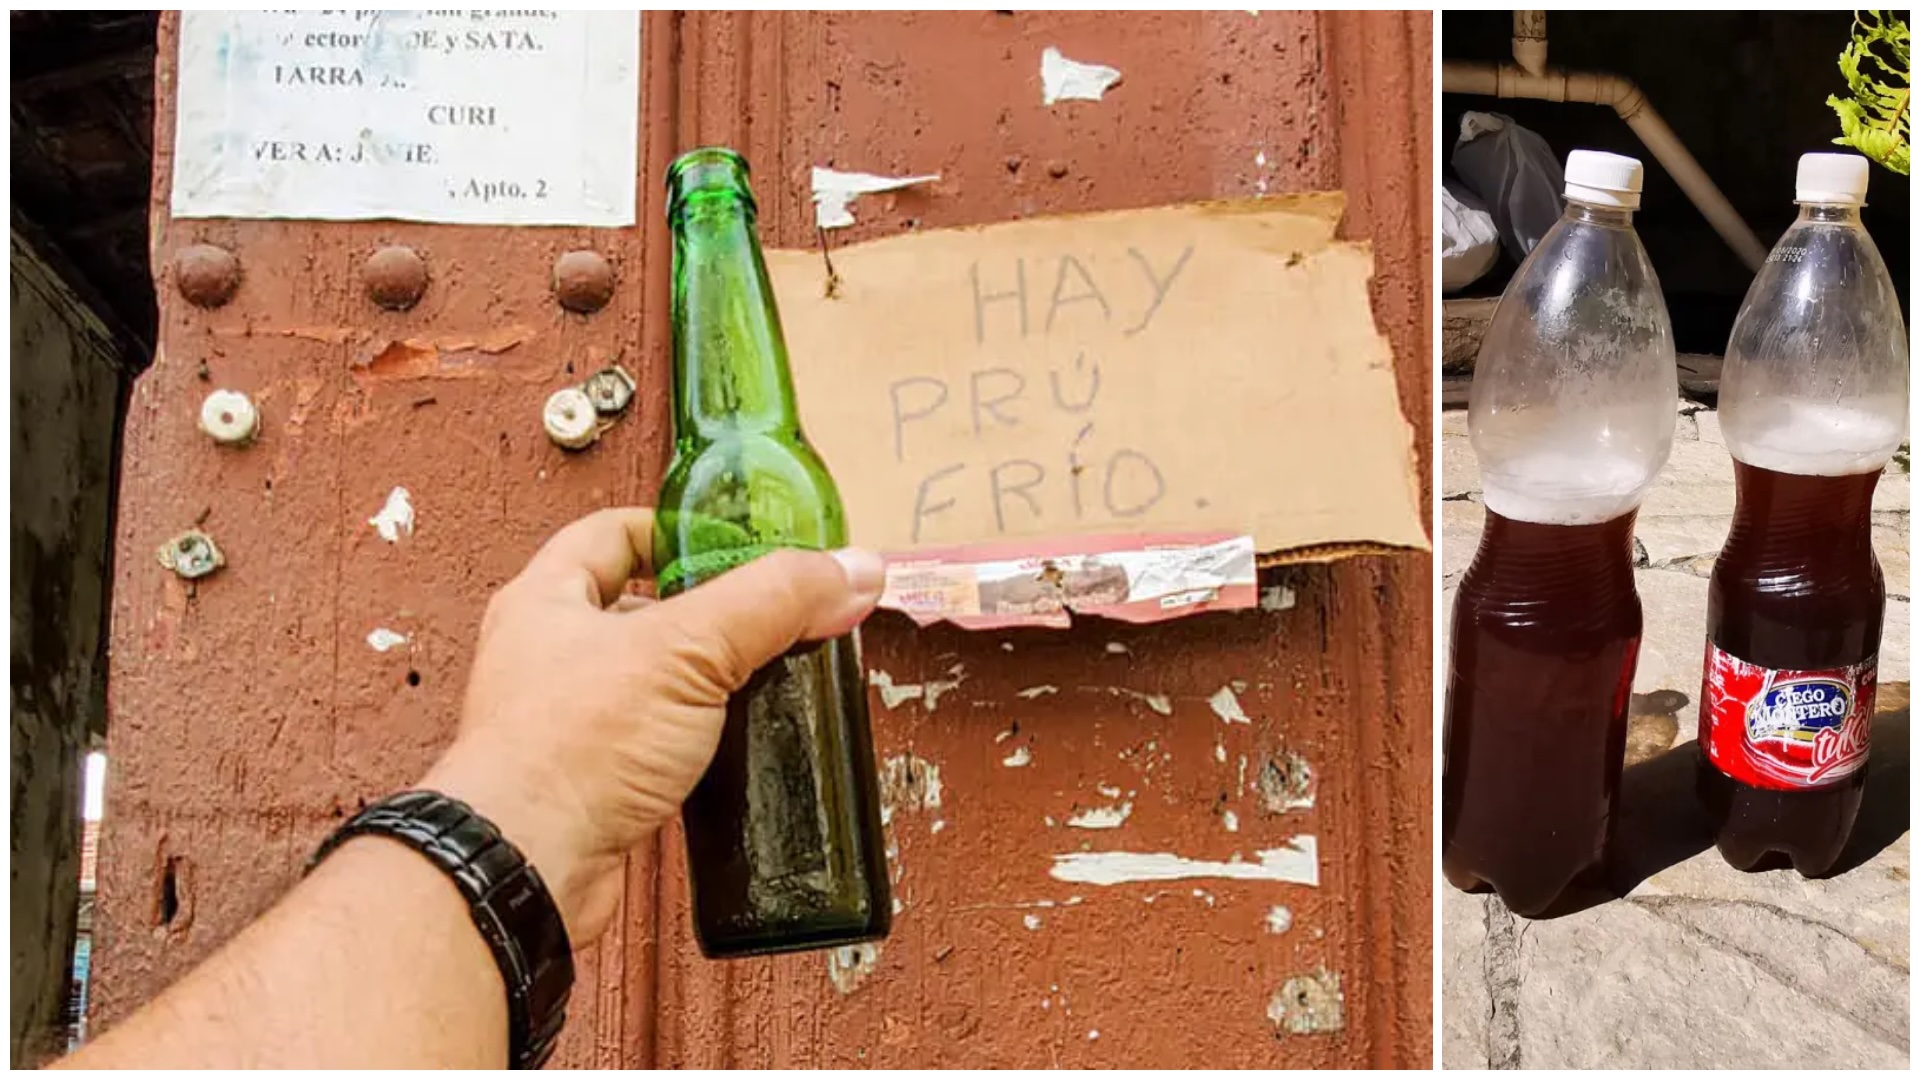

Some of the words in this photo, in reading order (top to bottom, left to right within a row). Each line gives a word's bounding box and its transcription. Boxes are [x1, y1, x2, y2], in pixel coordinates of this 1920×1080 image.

[444, 34, 459, 54] y
[465, 31, 544, 50] SATA.
[315, 143, 342, 163] A:
[463, 178, 527, 202] Apto.
[536, 179, 547, 198] 2
[970, 246, 1194, 344] HAY
[889, 350, 1101, 462] PRÚ
[911, 422, 1211, 543] FRÍO.
[1775, 688, 1825, 707] CIEGO
[1755, 697, 1845, 726] MONTERO
